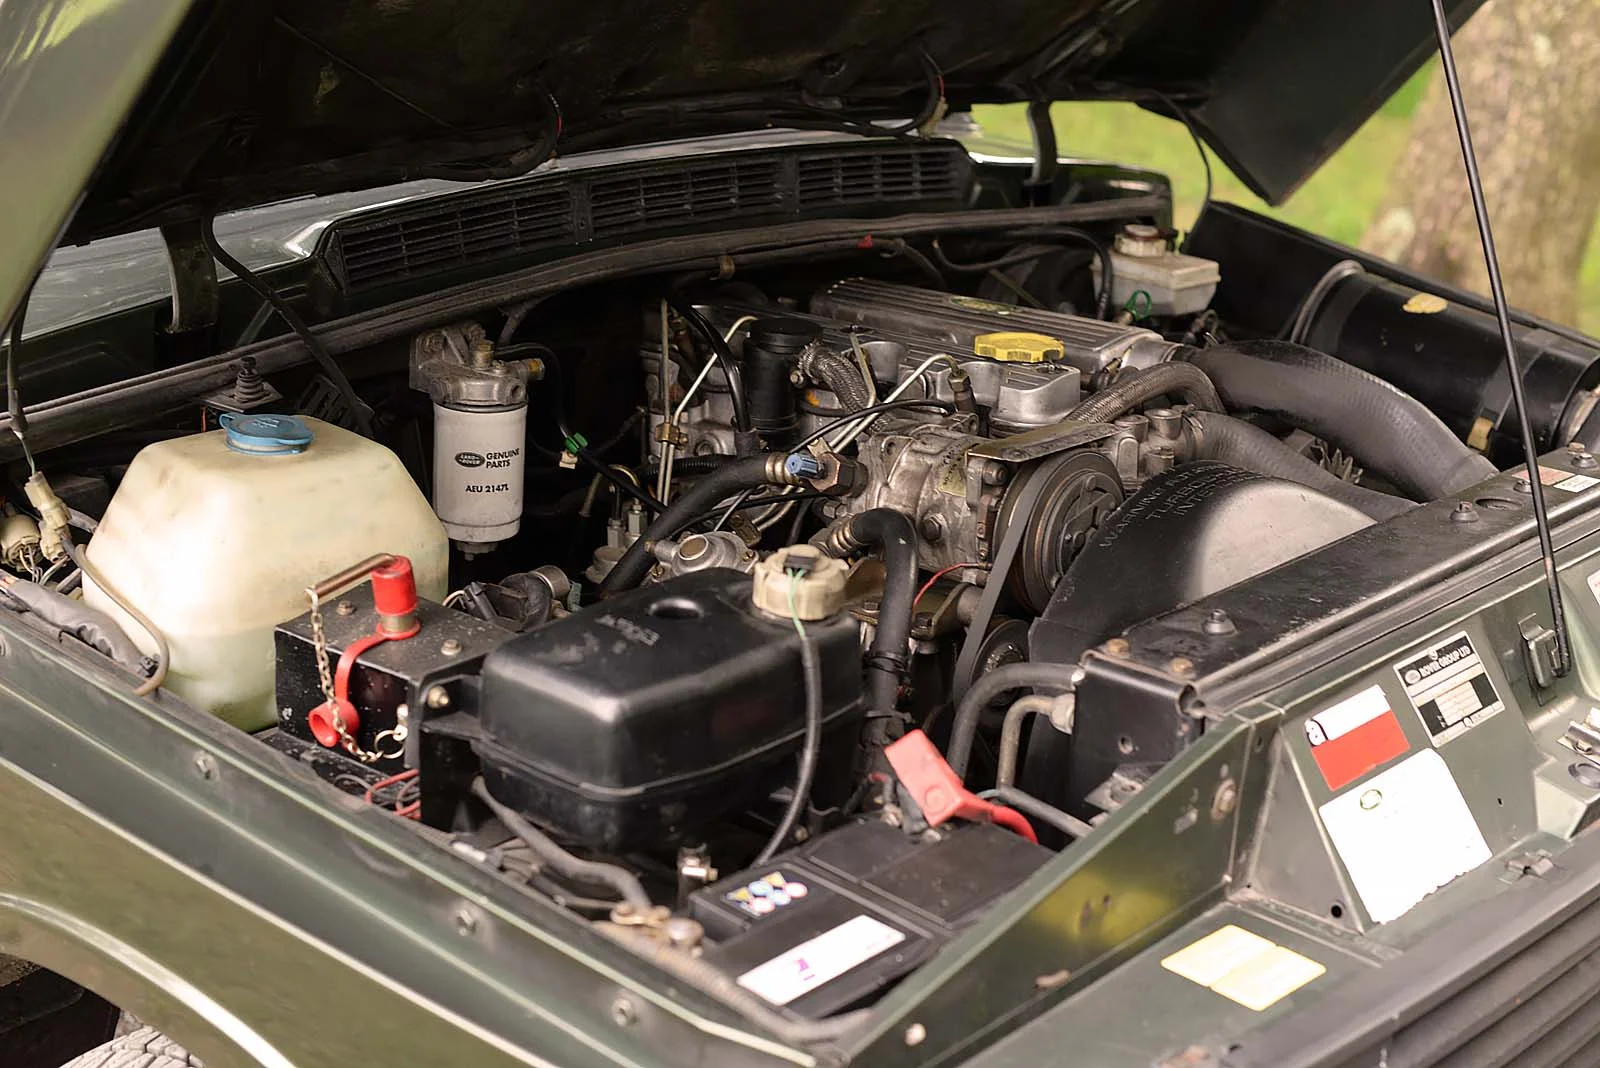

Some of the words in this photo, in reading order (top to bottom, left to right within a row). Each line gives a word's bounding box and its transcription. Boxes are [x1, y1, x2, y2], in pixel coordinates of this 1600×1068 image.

[486, 447, 520, 460] GENUINE
[486, 459, 511, 469] PARTS
[465, 485, 483, 493] AEU
[1438, 650, 1460, 667] GROUP
[1457, 645, 1471, 658] LTD
